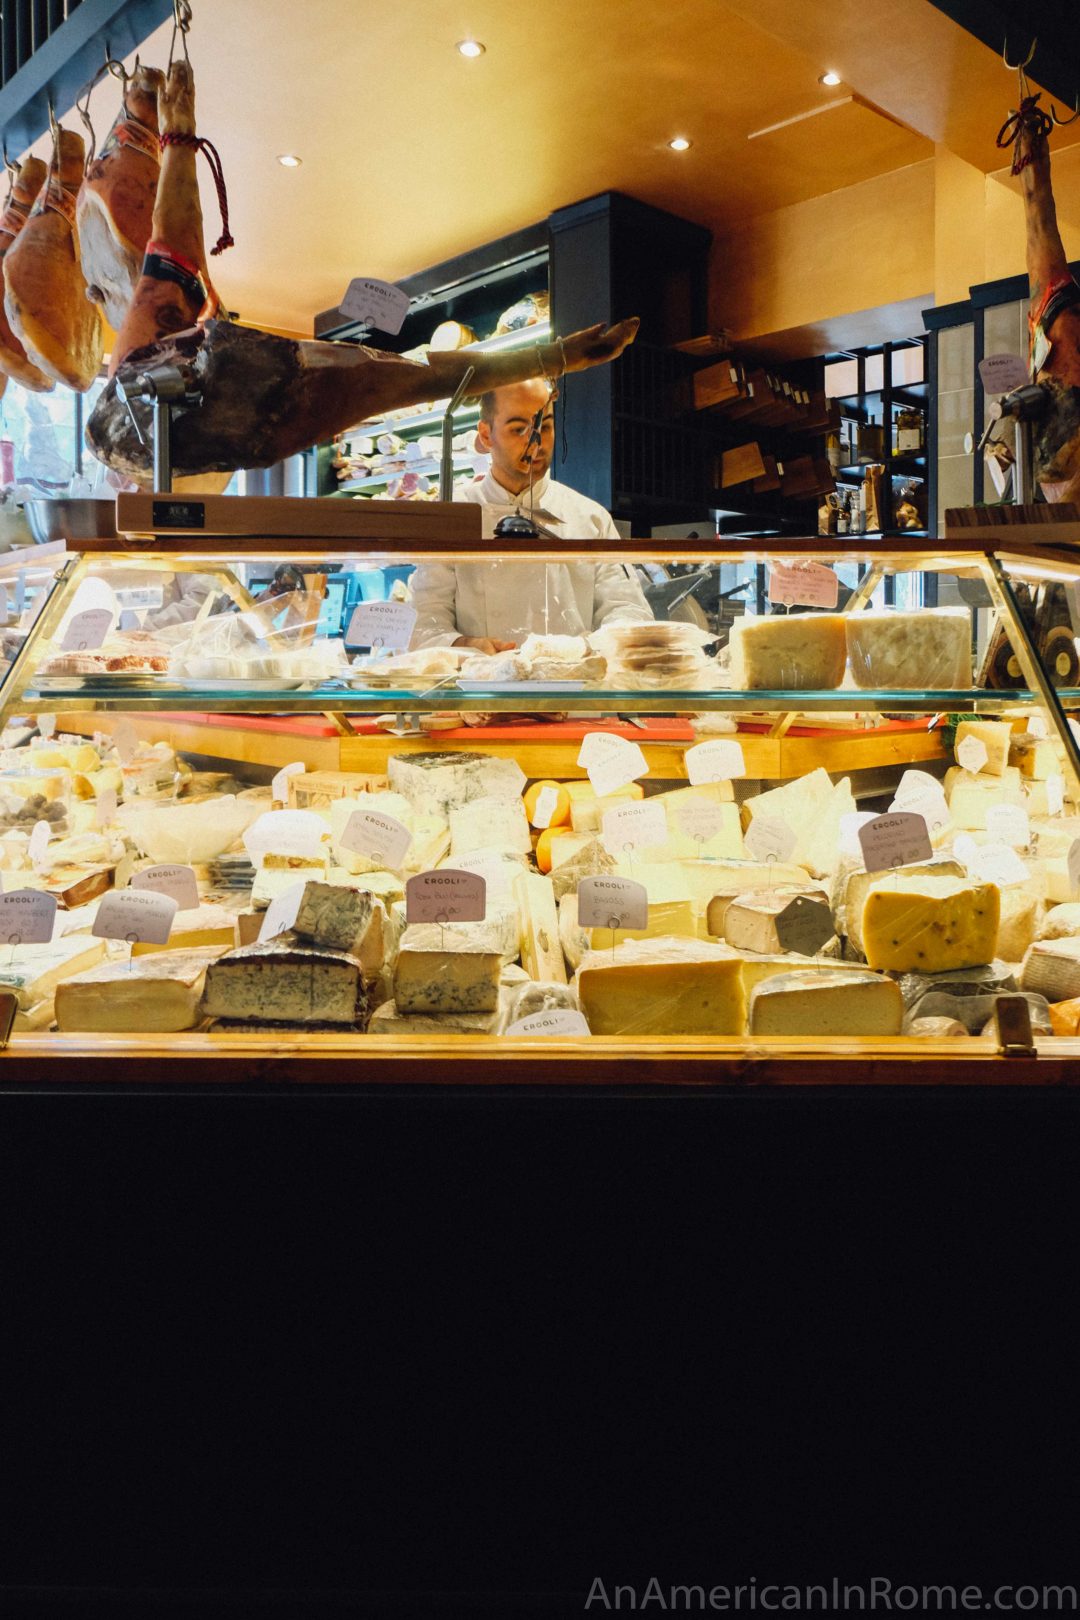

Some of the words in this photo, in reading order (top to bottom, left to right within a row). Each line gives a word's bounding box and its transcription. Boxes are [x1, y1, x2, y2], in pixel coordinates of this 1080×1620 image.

[364, 282, 392, 297] ERCOLI
[369, 606, 398, 614] ERCOLI
[617, 809, 645, 818] ERCOLI
[365, 815, 393, 832] ERCOLI
[872, 819, 902, 830] ERCOLI
[147, 870, 176, 879] ERCOLI
[593, 881, 624, 889] ERCOLI
[4, 896, 35, 904] ERCOLI
[120, 895, 154, 905] ERCOLI
[523, 1018, 558, 1031] ERCOLI
